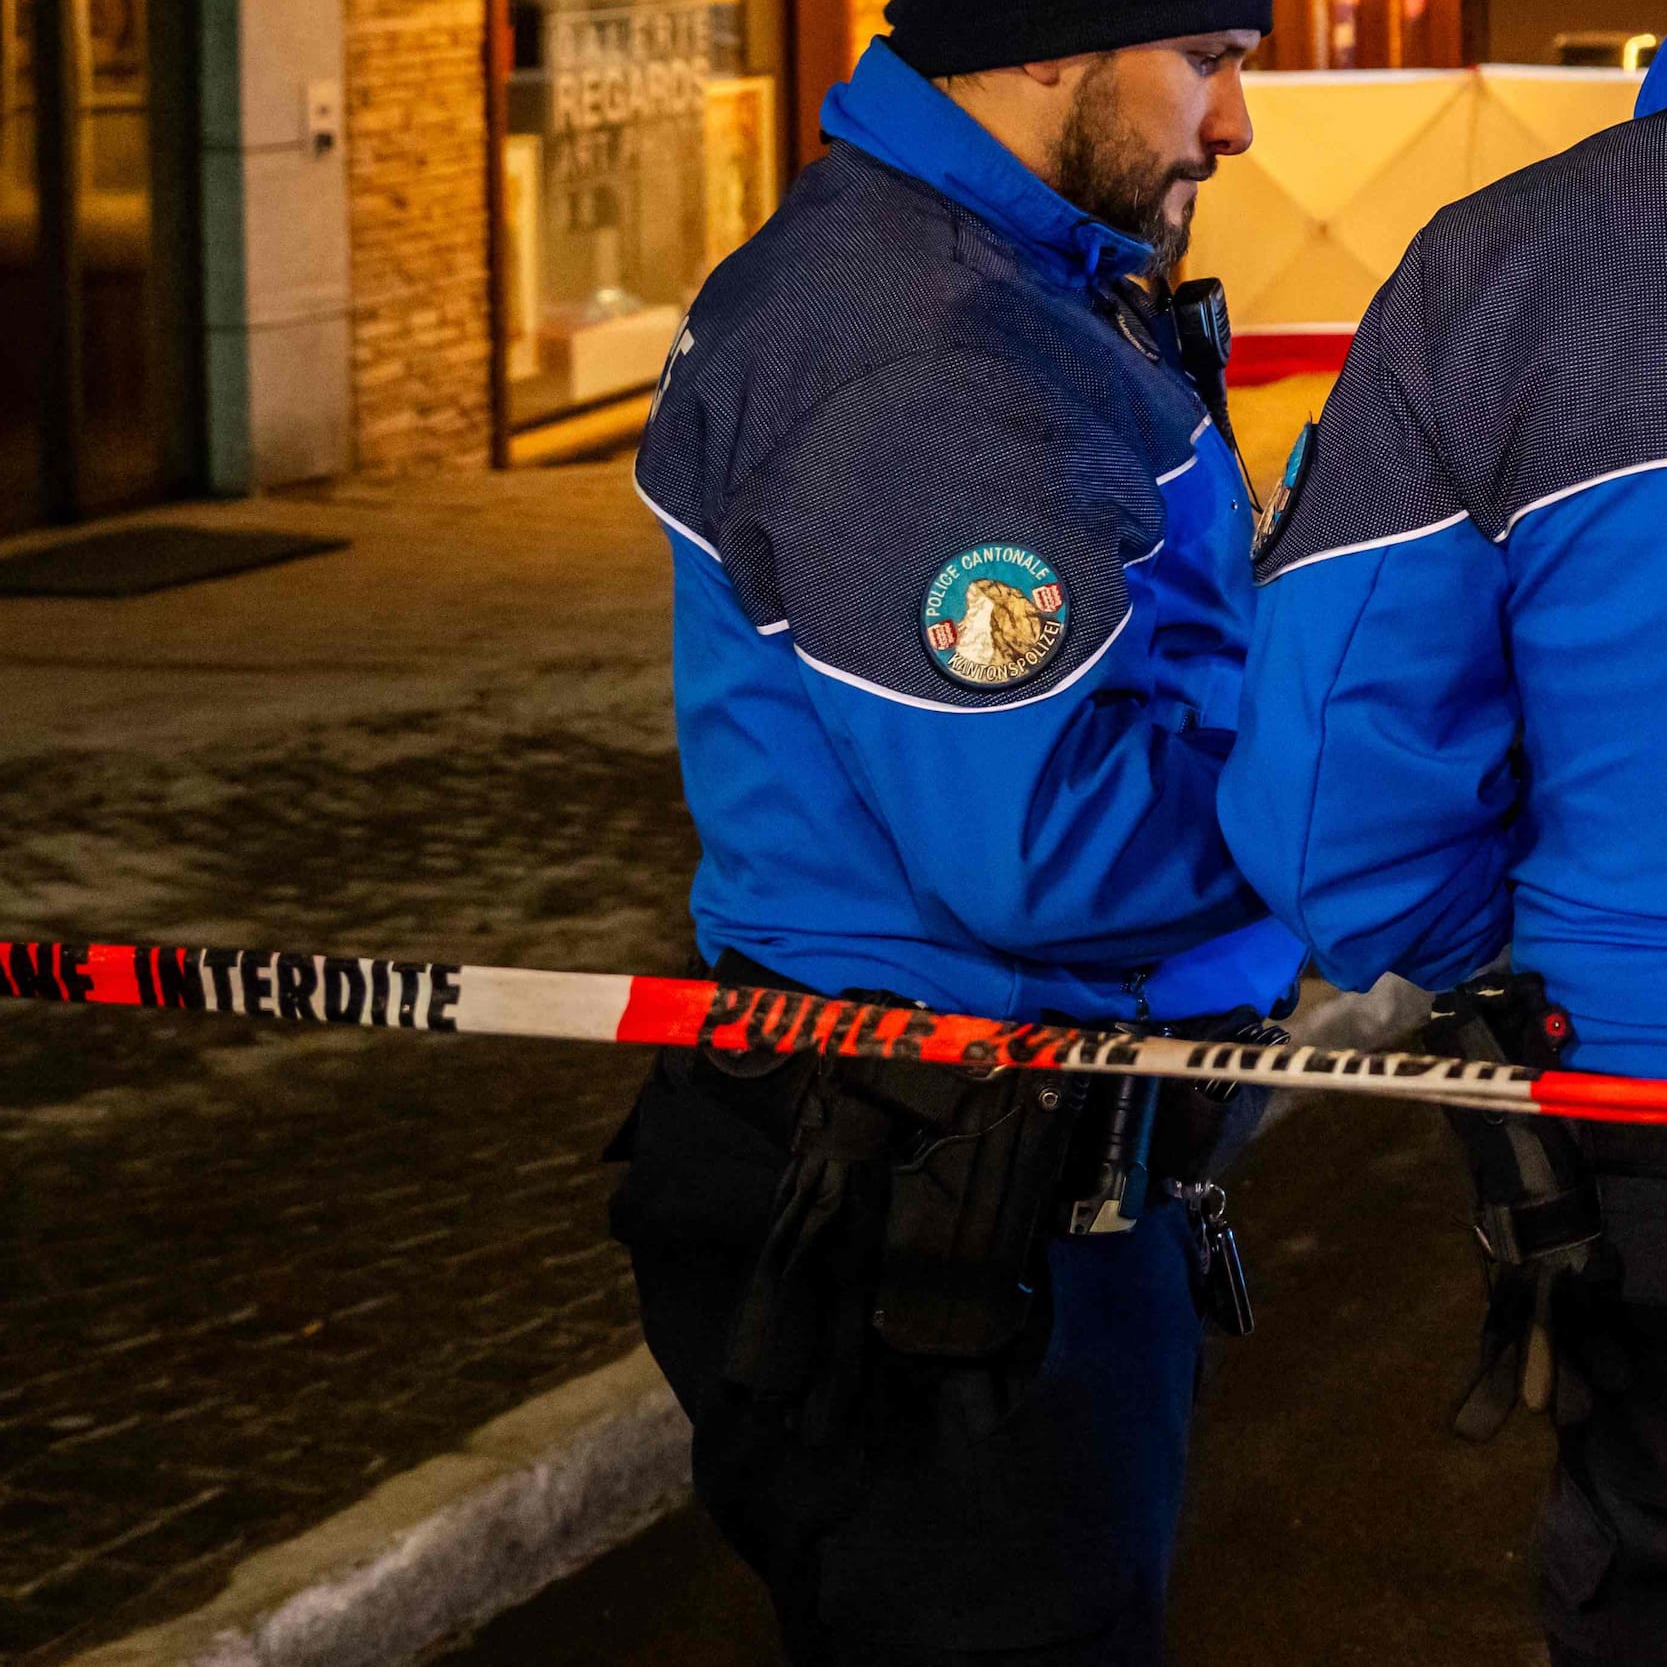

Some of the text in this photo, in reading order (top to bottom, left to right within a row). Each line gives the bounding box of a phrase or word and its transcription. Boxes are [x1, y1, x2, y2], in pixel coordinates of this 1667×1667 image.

[926, 546, 1051, 618] POLICE CANTONALE
[947, 620, 1062, 681] KANTONSPOLIZEI
[135, 945, 465, 1032] INTERDITE
